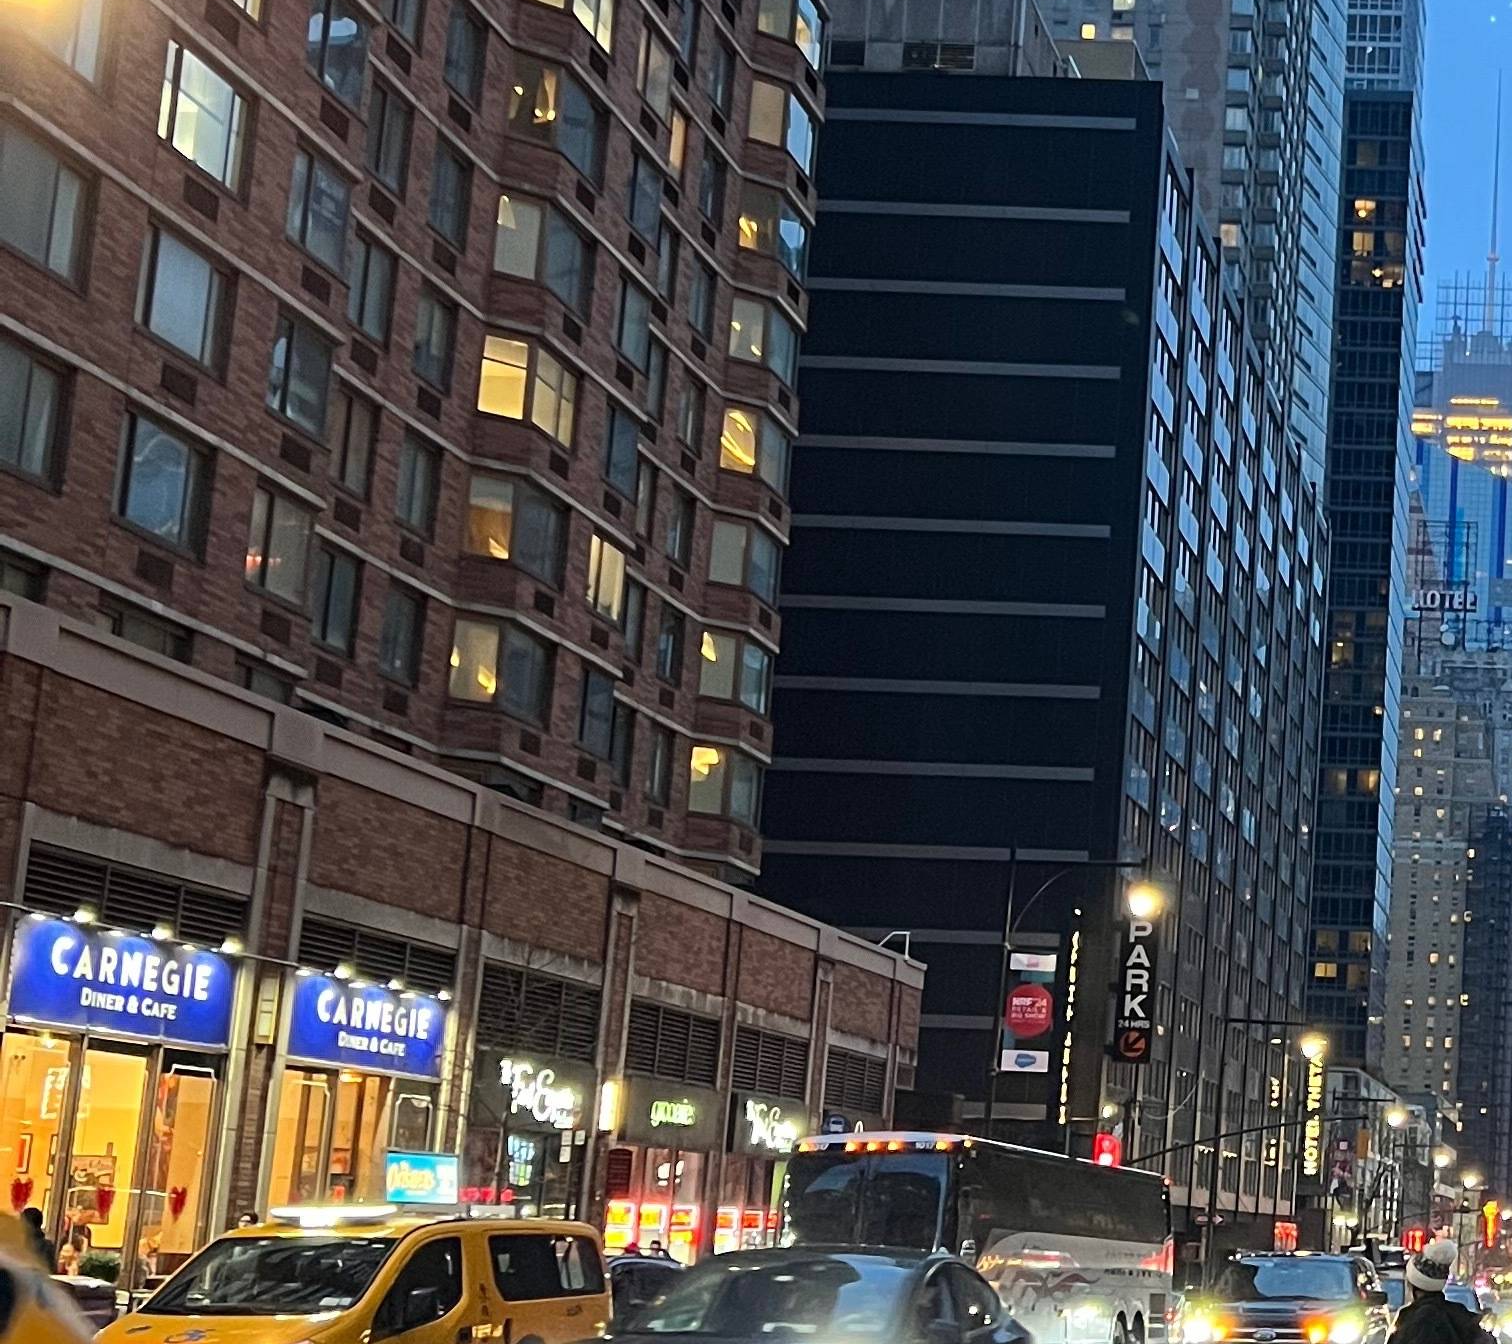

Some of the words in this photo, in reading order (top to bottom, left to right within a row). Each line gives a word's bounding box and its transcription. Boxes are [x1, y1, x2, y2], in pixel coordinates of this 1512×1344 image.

[51, 936, 212, 1001] CARNEGIE
[1123, 921, 1153, 1018] PARK
[126, 995, 139, 1014] &
[317, 989, 432, 1040] CARNEGIE
[1117, 1019, 1129, 1028] 24
[1130, 1019, 1150, 1029] HRS
